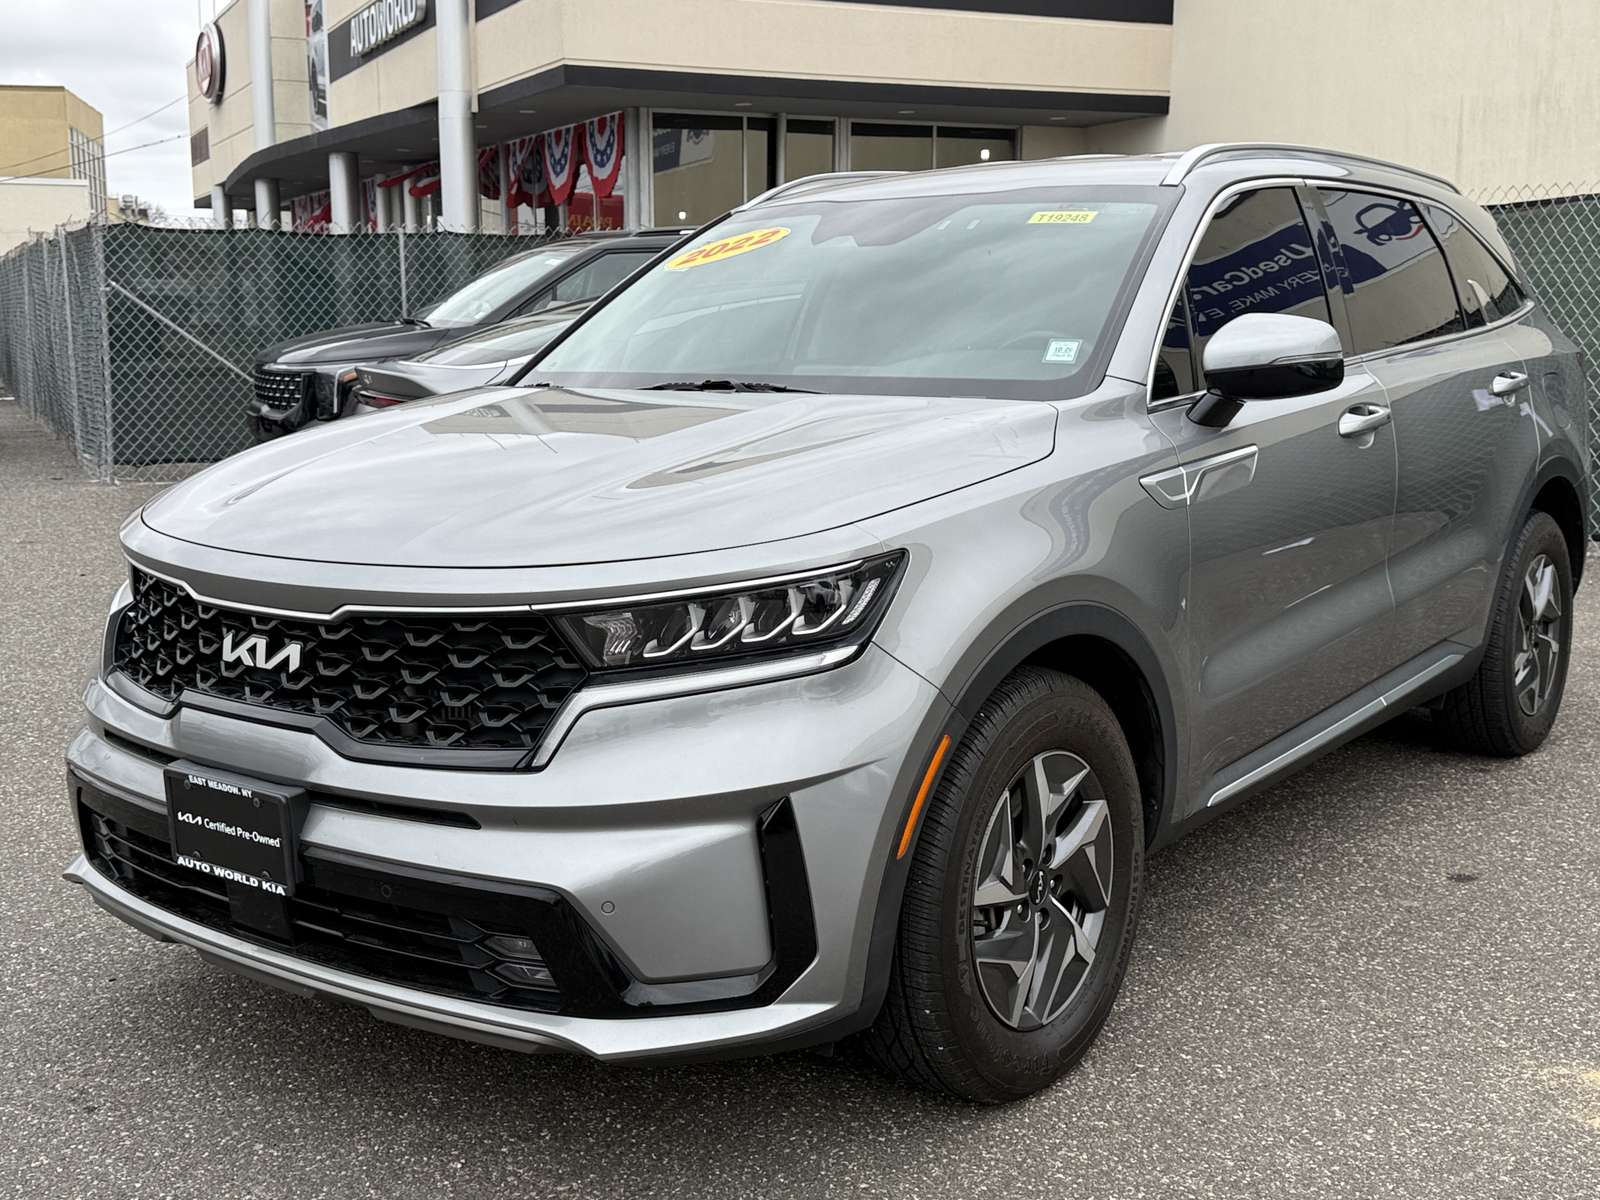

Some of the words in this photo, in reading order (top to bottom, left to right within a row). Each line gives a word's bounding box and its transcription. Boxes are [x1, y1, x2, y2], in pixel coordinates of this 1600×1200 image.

[1037, 213, 1090, 223] T19248
[675, 229, 781, 267] 2022
[222, 632, 302, 674] KIA
[188, 774, 208, 787] EAST
[241, 788, 253, 798] NY
[177, 811, 203, 826] KIA
[203, 818, 236, 836] Certified
[236, 827, 281, 848] Pre-Owned
[177, 856, 211, 873] AUTO
[212, 866, 259, 887] WORLD
[261, 880, 286, 896] KIA
